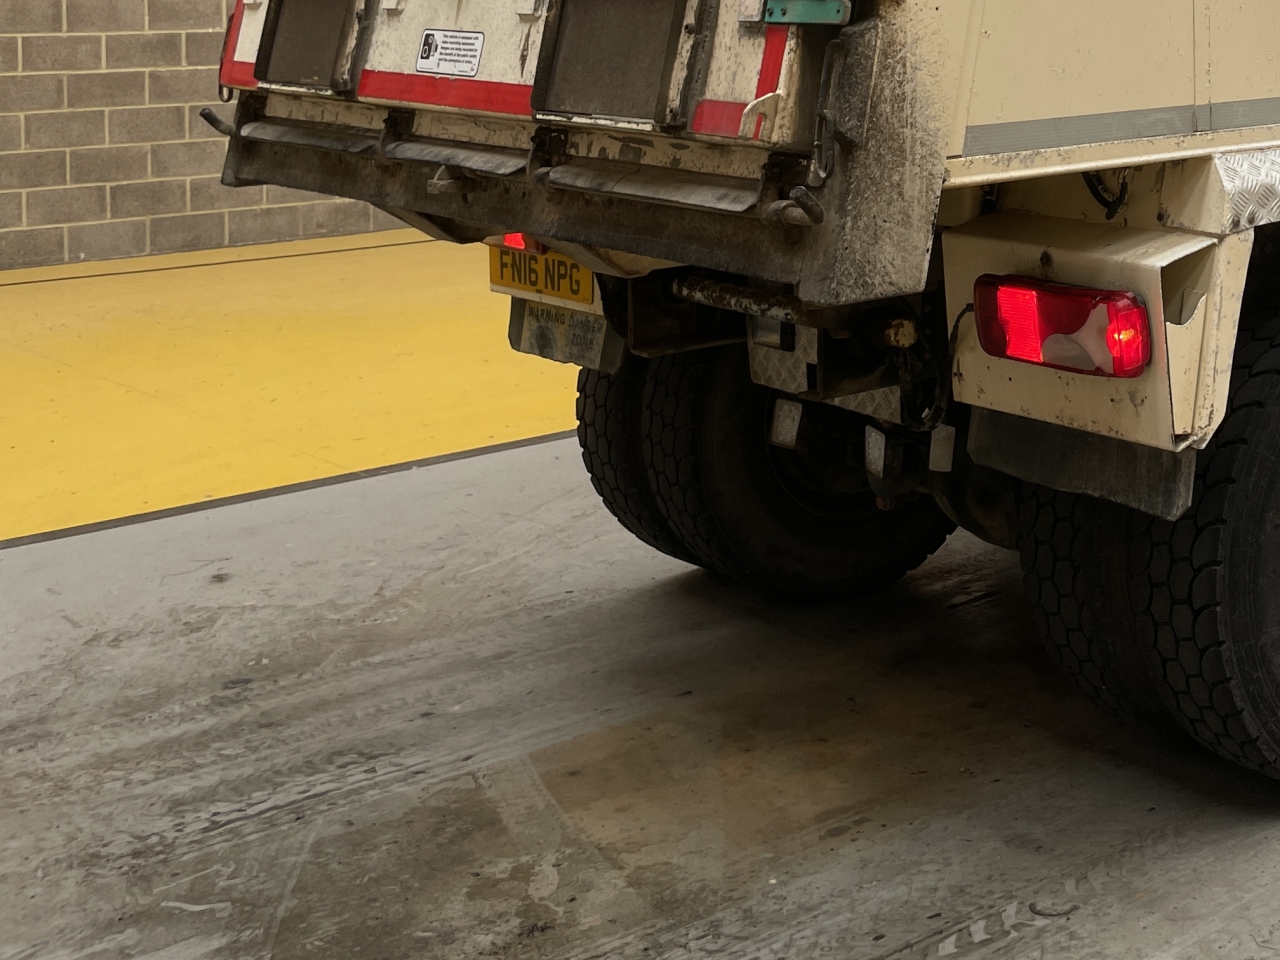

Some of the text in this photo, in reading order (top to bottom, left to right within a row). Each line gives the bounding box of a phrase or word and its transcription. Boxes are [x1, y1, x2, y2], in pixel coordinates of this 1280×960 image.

[500, 249, 580, 296] FN16 NPG
[528, 305, 566, 325] WARNING
